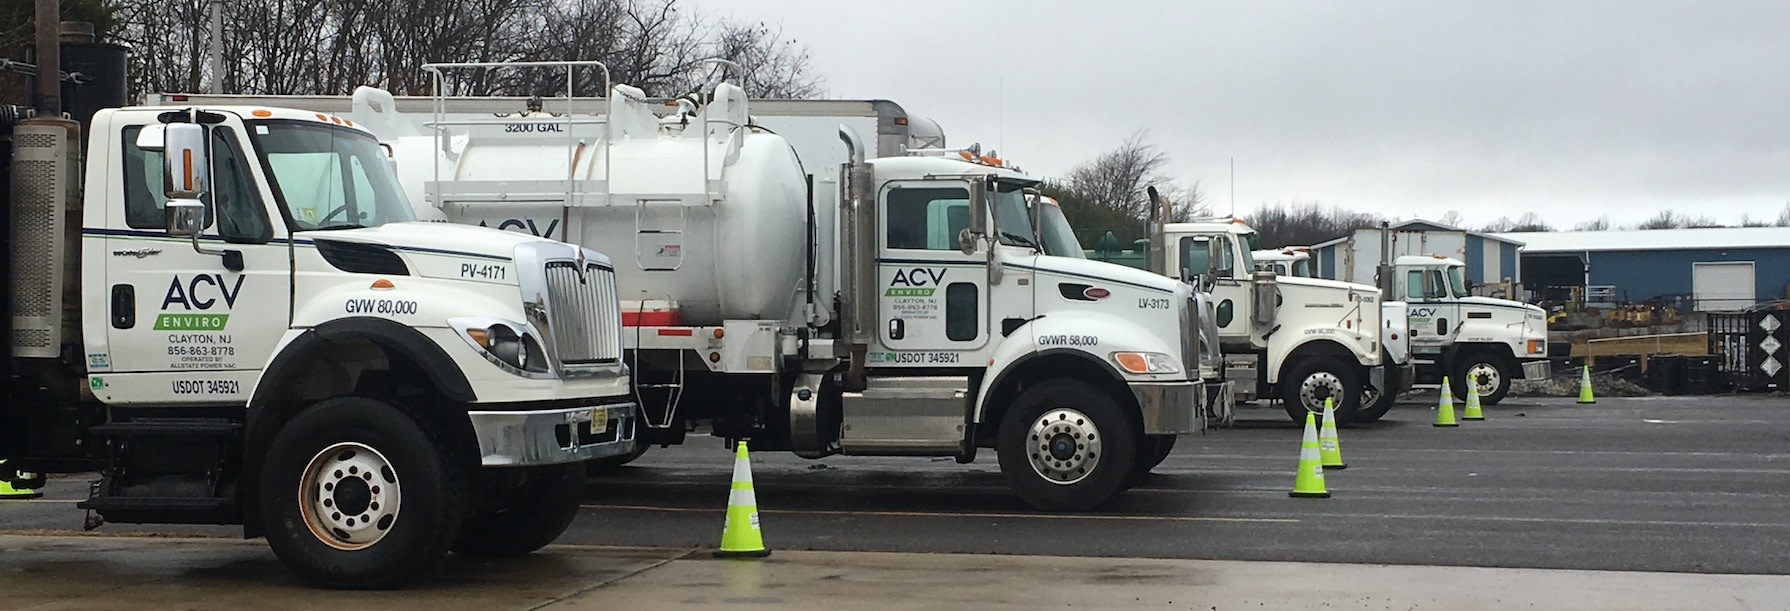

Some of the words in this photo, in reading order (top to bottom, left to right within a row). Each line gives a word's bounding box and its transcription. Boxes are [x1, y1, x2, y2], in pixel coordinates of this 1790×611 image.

[504, 123, 534, 133] 3200
[536, 123, 563, 133] GAL
[461, 263, 505, 280] PV-4171
[890, 267, 947, 287] ACV
[160, 273, 246, 311] ACV
[890, 288, 931, 296] ENVIRO
[345, 299, 376, 314] GVW
[377, 301, 417, 316] 80,000
[1138, 298, 1170, 309] LV-3173
[1409, 308, 1437, 318] ACV
[163, 315, 222, 327] ENVIRO
[168, 334, 216, 345] CLAYTON,
[219, 334, 232, 344] NJ
[1039, 335, 1067, 346] GVWR
[1069, 335, 1098, 347] 58,000
[167, 346, 235, 356] 856-863-8778
[894, 352, 926, 363] USDOT
[928, 353, 960, 363] 345921
[172, 380, 204, 394] USDOT
[206, 380, 240, 394] 345921
